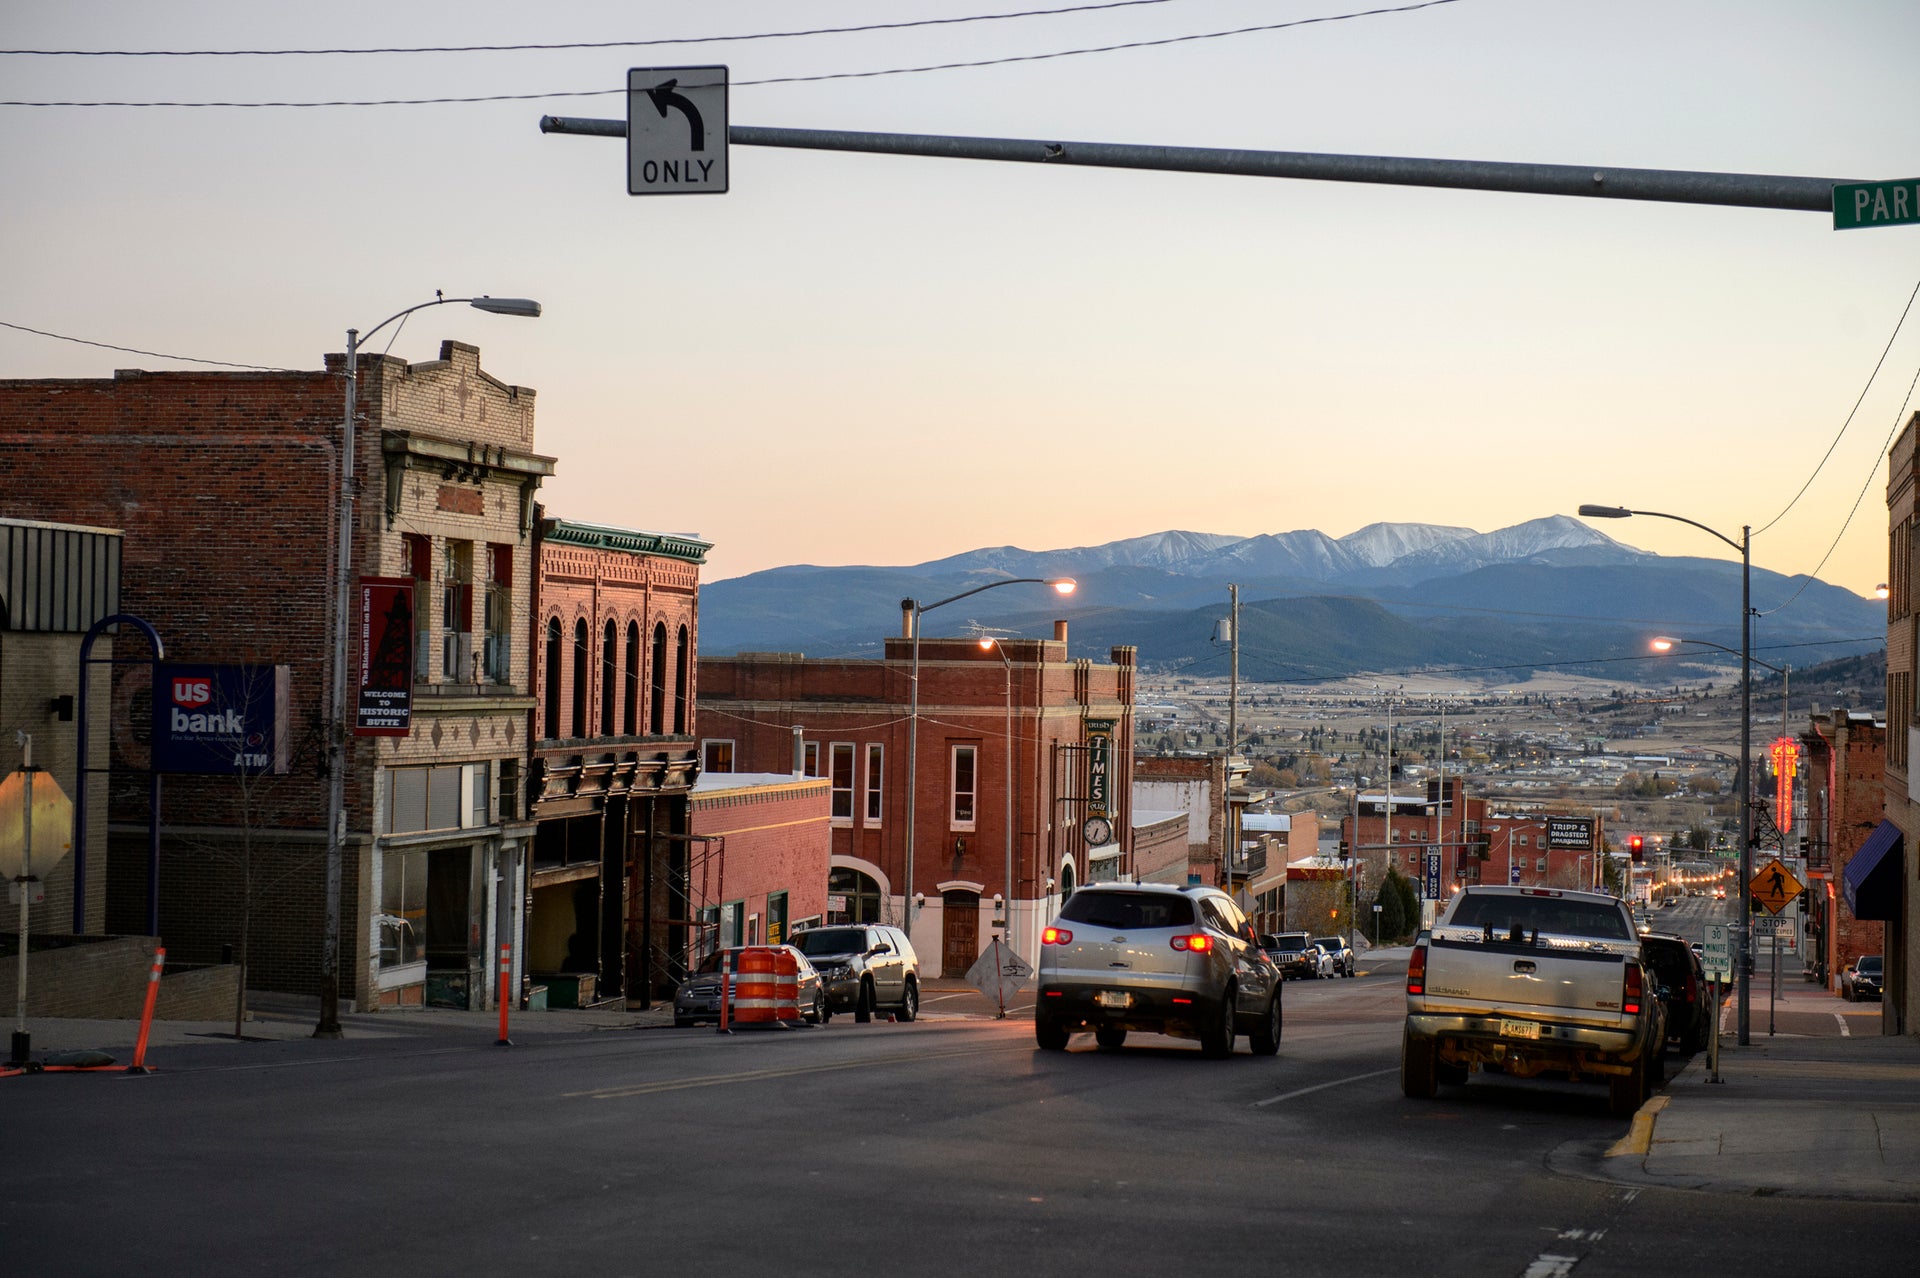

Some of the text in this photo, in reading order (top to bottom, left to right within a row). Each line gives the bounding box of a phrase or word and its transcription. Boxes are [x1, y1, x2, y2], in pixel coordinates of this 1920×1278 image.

[643, 160, 714, 183] ONLY
[174, 683, 209, 702] us
[359, 708, 409, 716] HISTORIC
[171, 707, 244, 733] bank
[366, 718, 400, 726] BUTTE
[233, 753, 268, 767] ATM
[1092, 736, 1105, 800] TIMES
[1552, 823, 1578, 831] TRIPP
[1430, 856, 1438, 876] BODY
[1430, 878, 1438, 898] SHOP
[1762, 919, 1787, 928] STOP
[1711, 930, 1722, 940] 30
[1705, 943, 1727, 954] MINUTE
[1704, 956, 1728, 967] PARKING
